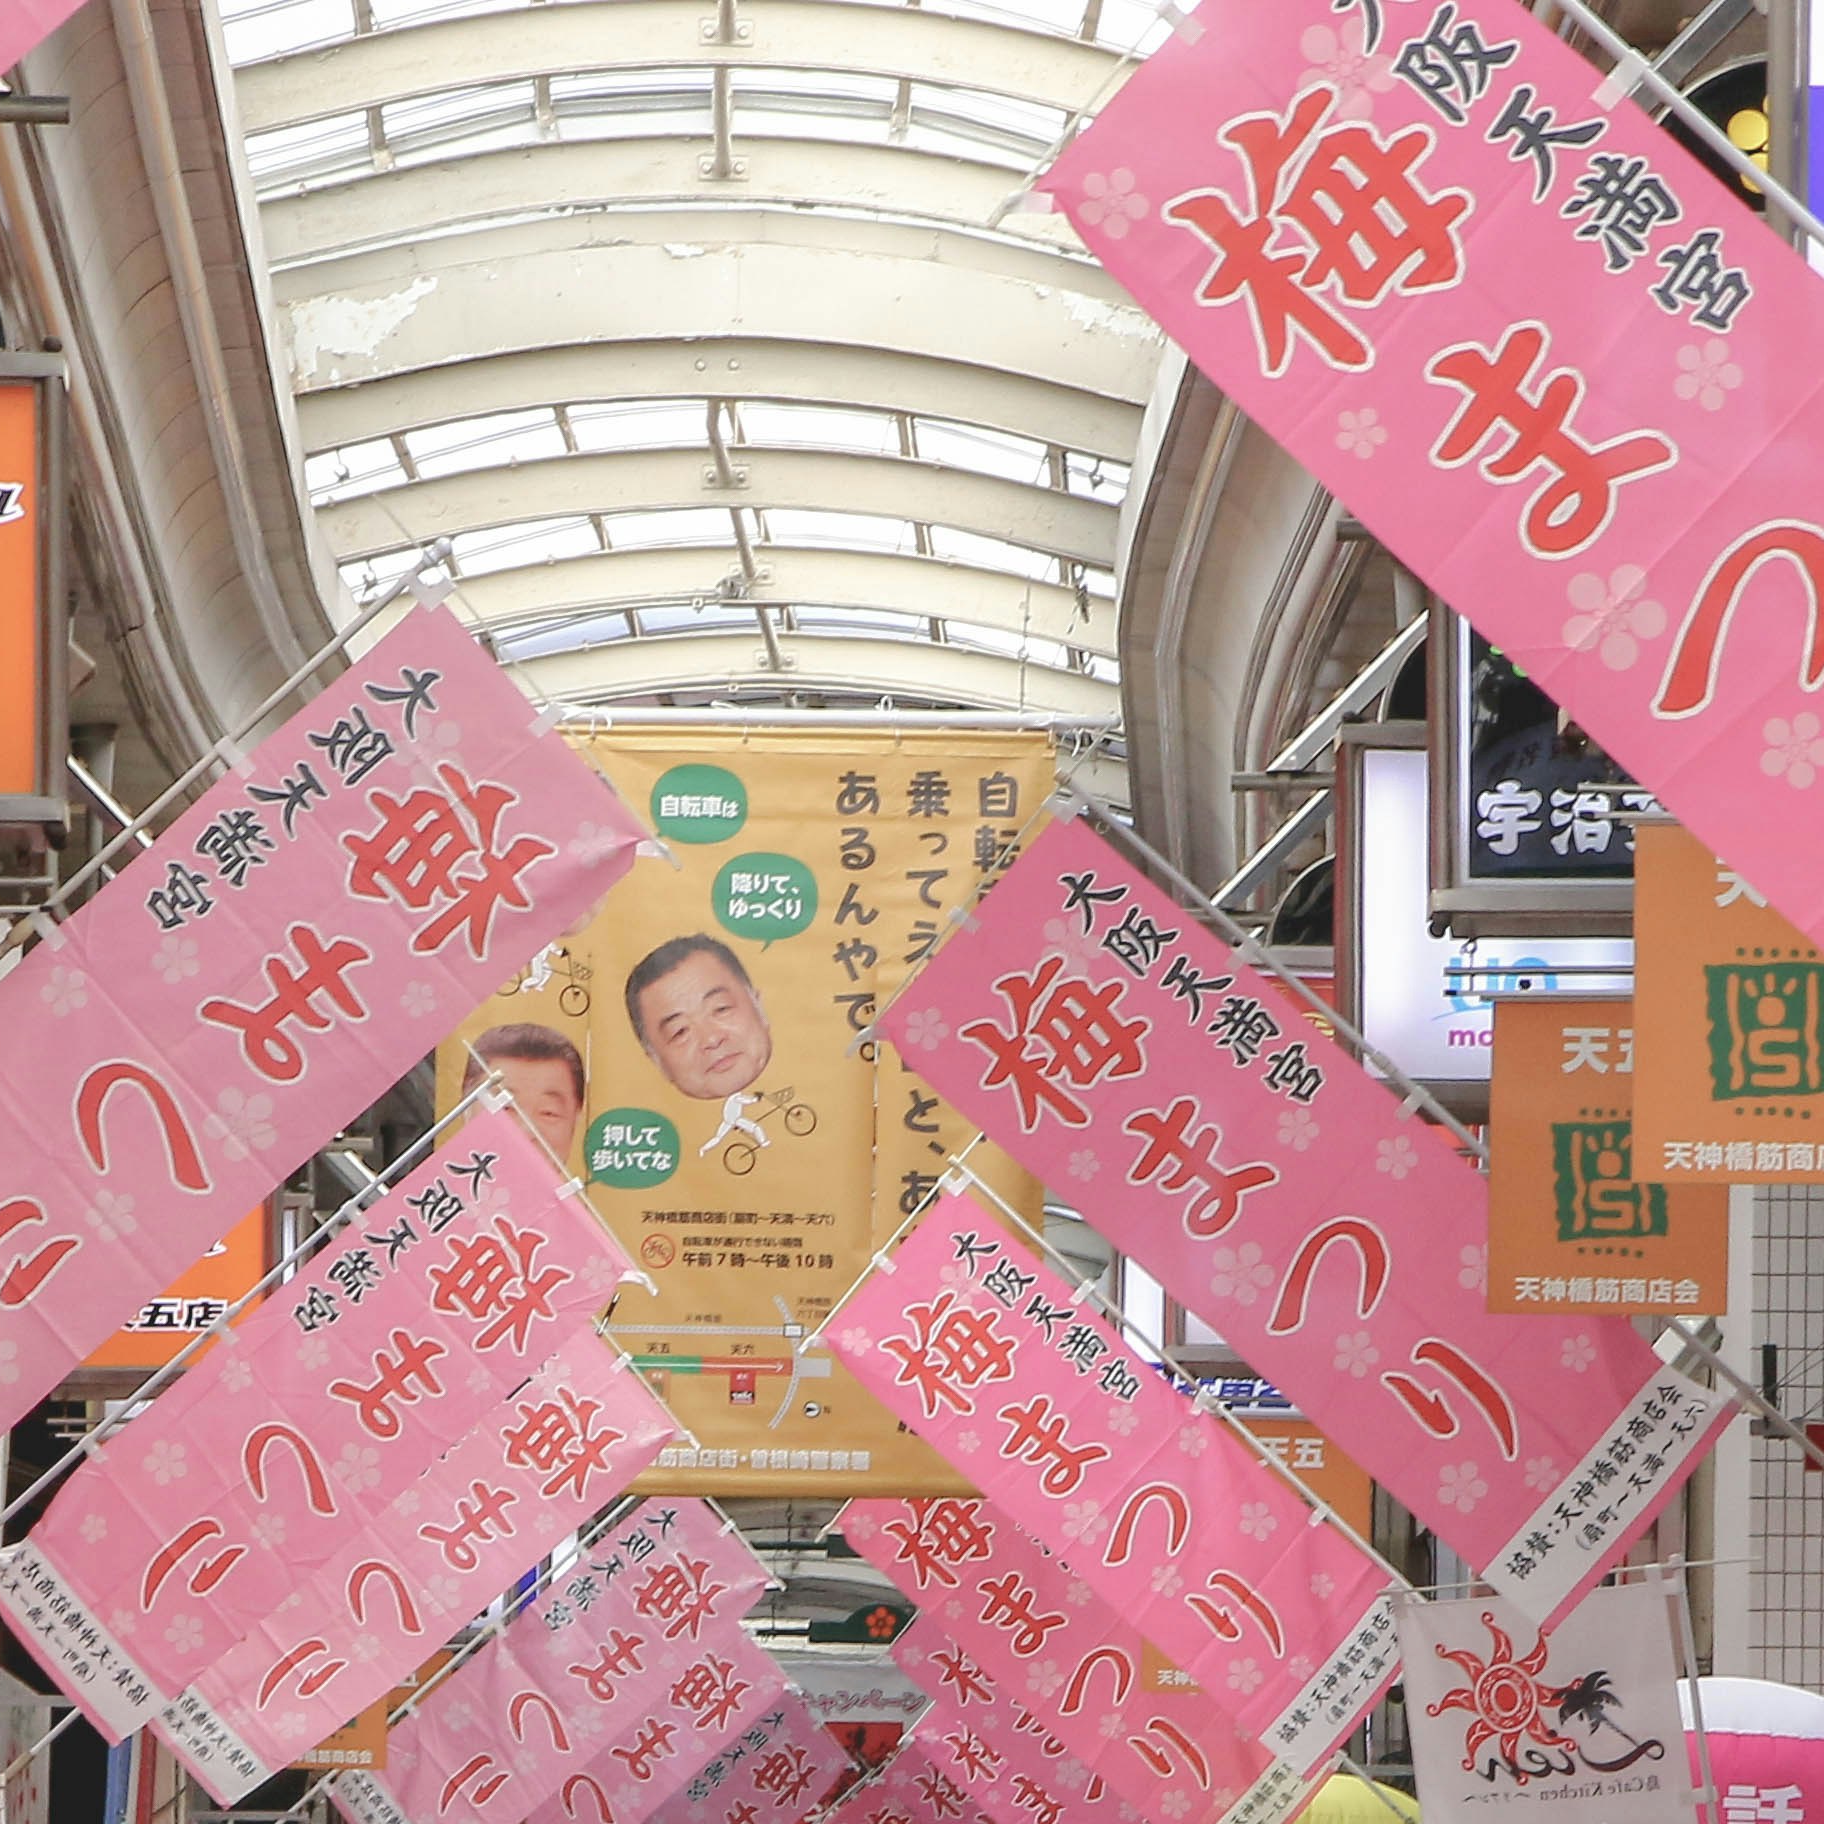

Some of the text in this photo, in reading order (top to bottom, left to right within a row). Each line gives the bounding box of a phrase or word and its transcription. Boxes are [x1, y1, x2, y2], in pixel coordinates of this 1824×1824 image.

[659, 794, 740, 820] 自転車は
[729, 896, 804, 920] ゆっくり
[1056, 869, 1328, 1106] 大阪天満宮
[603, 1125, 662, 1148] 押して
[592, 1148, 672, 1172] 歩いてな
[959, 955, 1518, 1463] 梅まつり
[1514, 1276, 1701, 1306] 天神橋筋商店会
[950, 1228, 1145, 1405] 大阪天満宮
[647, 1342, 671, 1354] 天五
[730, 1343, 755, 1355] 天六
[1255, 1435, 1327, 1471] 天五
[877, 1290, 1285, 1661] 梅まつり
[882, 1495, 1213, 1793] 梅まつり
